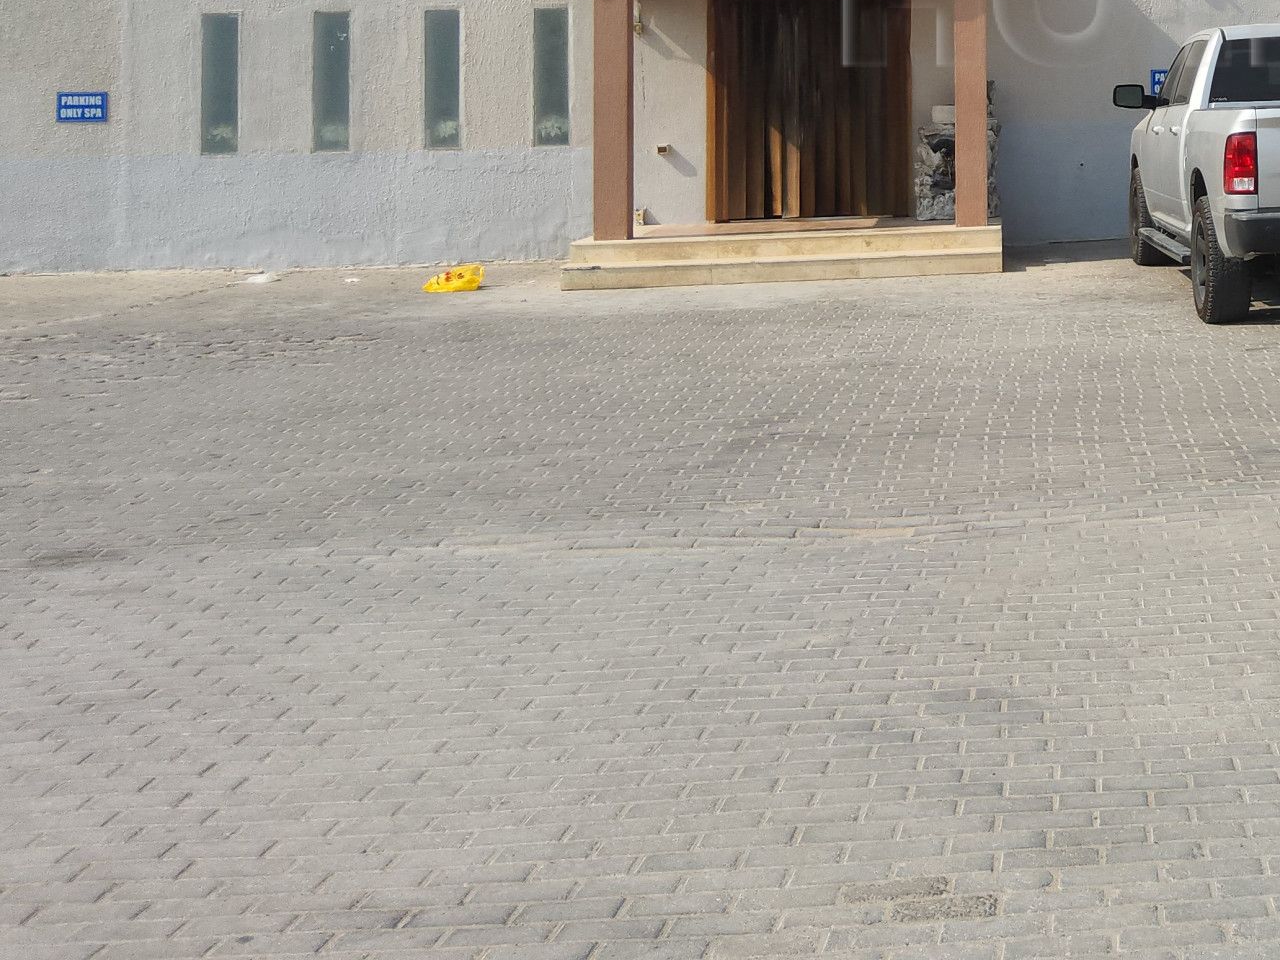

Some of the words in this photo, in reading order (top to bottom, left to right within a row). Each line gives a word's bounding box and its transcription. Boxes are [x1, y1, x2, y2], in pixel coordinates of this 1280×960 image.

[61, 96, 102, 106] PARKING
[60, 108, 83, 118] ONLY
[84, 108, 102, 118] SPA
